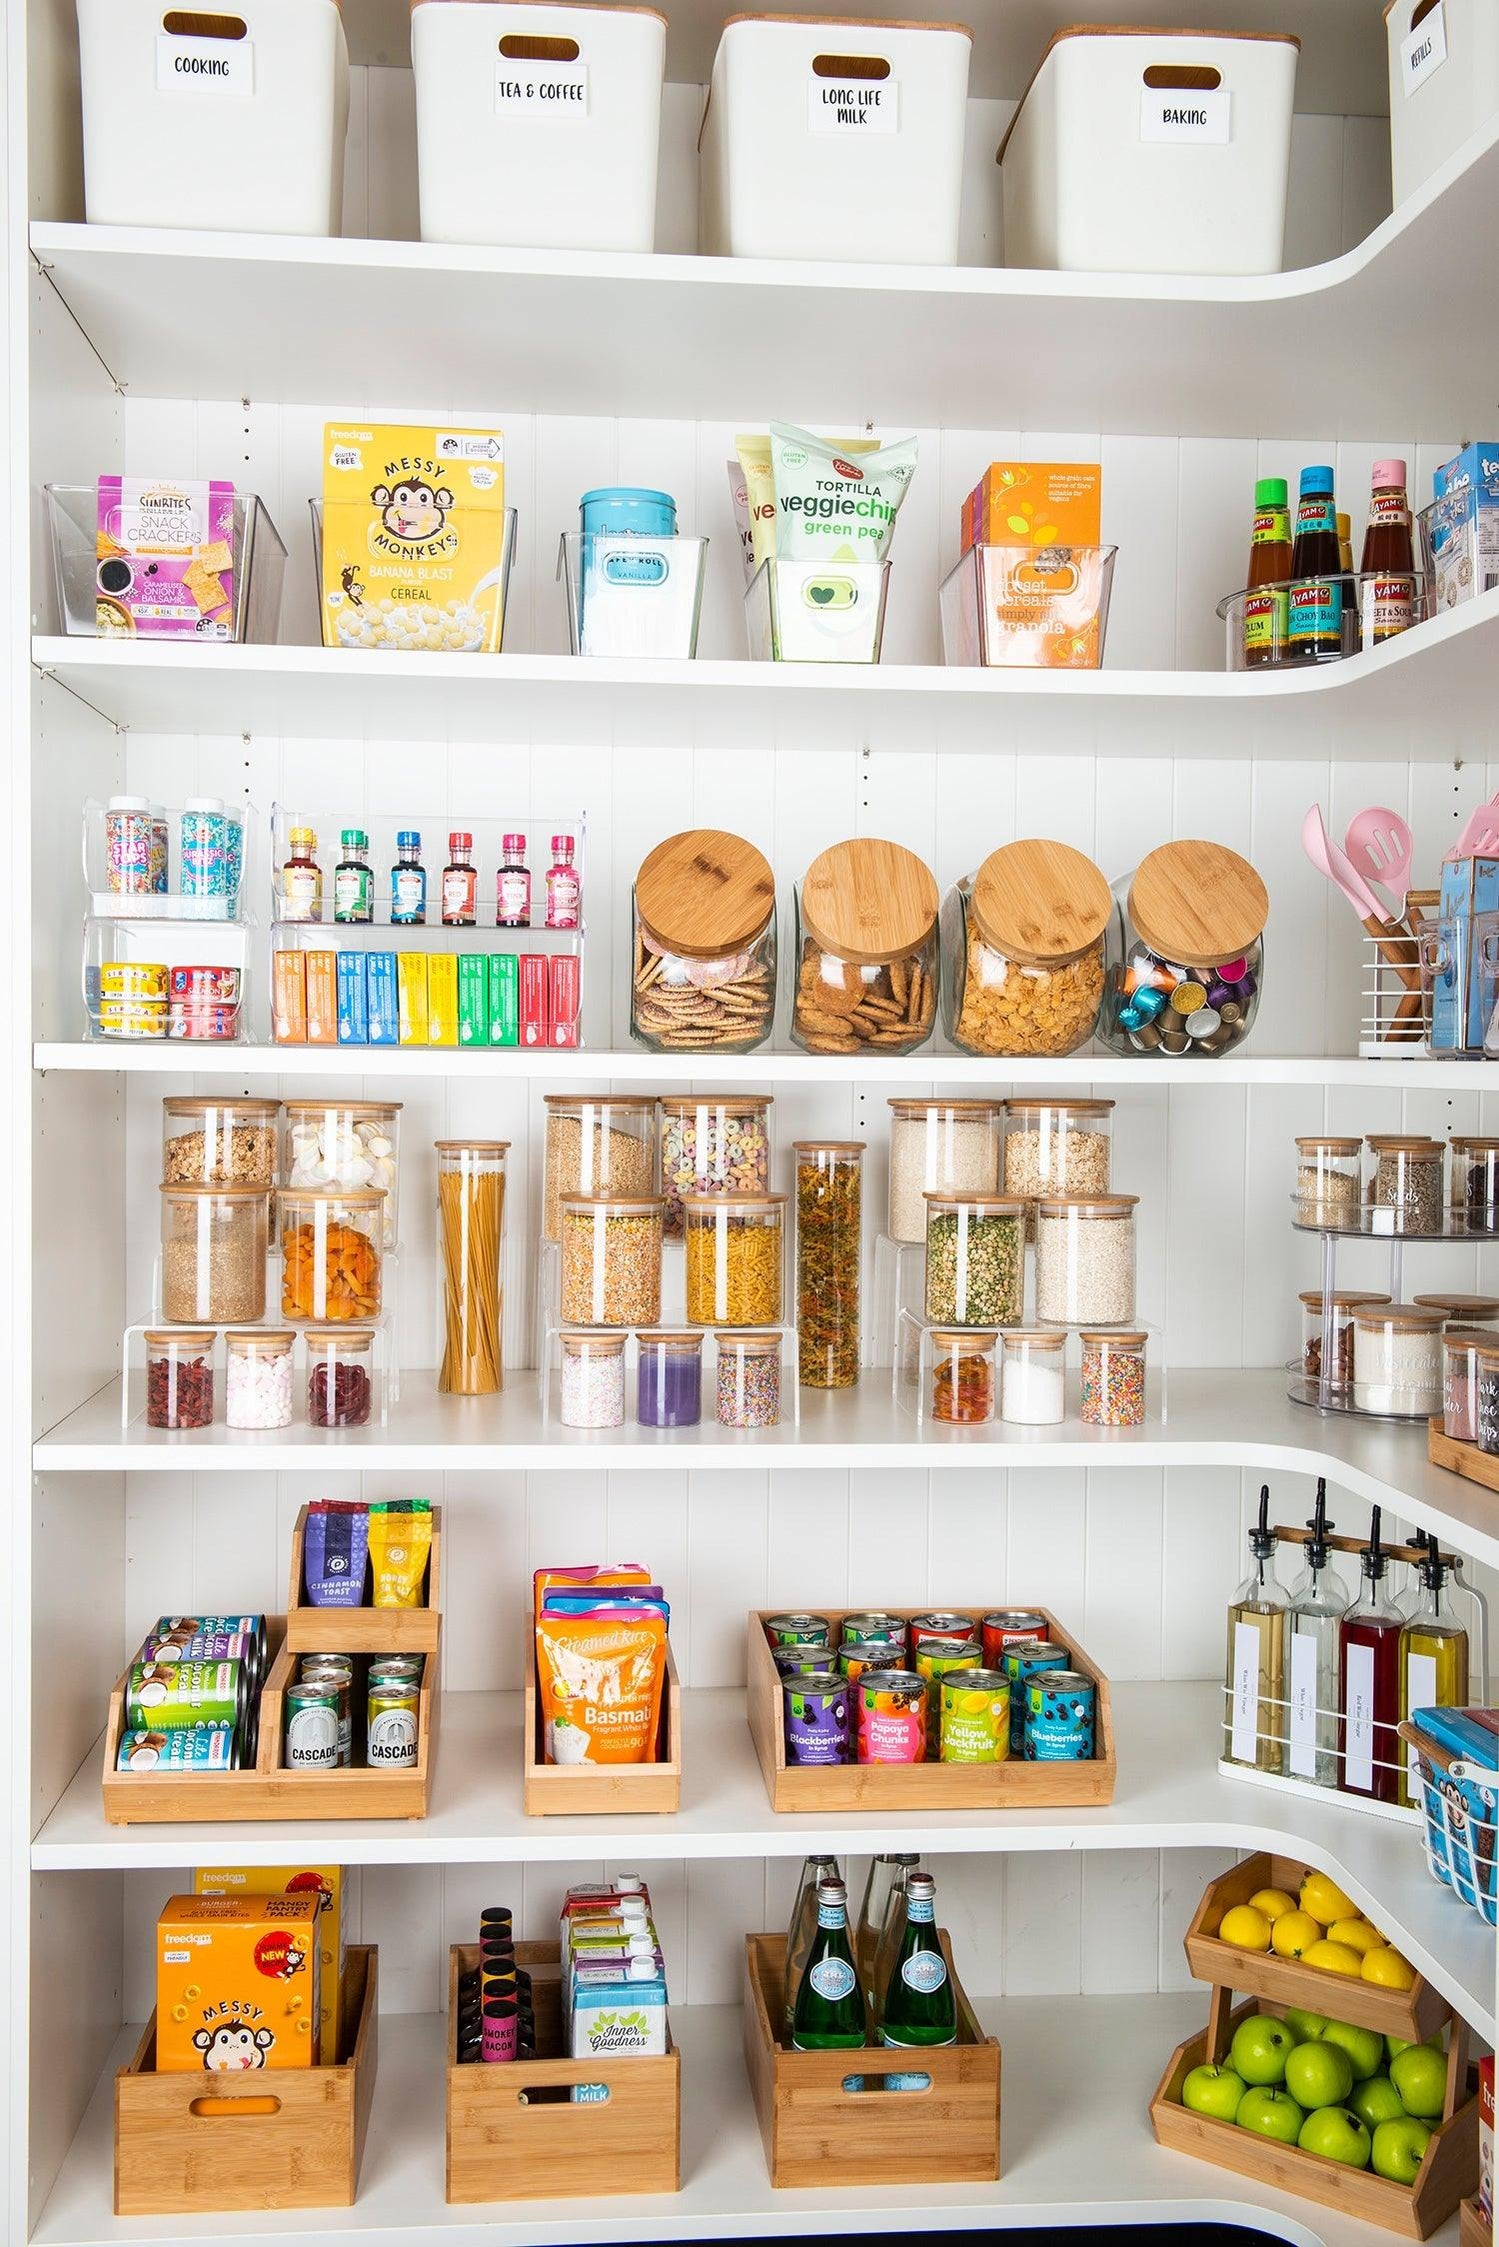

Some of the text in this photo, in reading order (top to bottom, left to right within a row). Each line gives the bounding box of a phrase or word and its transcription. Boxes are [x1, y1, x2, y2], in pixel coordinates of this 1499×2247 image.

[174, 57, 229, 77] COOKING
[499, 81, 583, 101] TEA & COFFEE
[823, 89, 882, 106] LONG LIFE
[838, 108, 867, 124] MILK
[1163, 108, 1207, 125] BAKING
[336, 457, 355, 465] FREE
[384, 457, 445, 477] MESSY
[816, 480, 882, 497] TORTILLA
[140, 497, 192, 510] SUNRITES
[781, 494, 898, 525] veggiechip
[1373, 499, 1400, 514] AYAM
[141, 516, 188, 529] SNACK
[804, 521, 884, 540] green pea
[127, 529, 202, 543] CRACKERS
[374, 534, 457, 558] MONKEYS
[369, 567, 454, 580] BANANA BLAST
[144, 588, 175, 596] ONION
[391, 588, 432, 600] CEREAL
[1290, 590, 1318, 609] AYAM
[112, 841, 147, 854] STAR
[112, 852, 149, 865] TOPS
[107, 970, 148, 978] SIRNA
[1479, 1381, 1498, 1397] ark
[311, 1580, 362, 1590] CINNAMON
[324, 1588, 350, 1596] TOAST
[204, 1616, 216, 1634] Cre
[190, 1636, 203, 1657] Milk
[214, 1636, 228, 1656] Lite
[556, 1629, 649, 1653] Steamed Rice
[178, 1663, 191, 1703] Cream
[190, 1661, 206, 1708] Coconut
[871, 1721, 909, 1735] Papaya
[950, 1724, 987, 1738] Yellow
[1031, 1729, 1083, 1742] Blueberries
[790, 1733, 845, 1746] Blackberries
[871, 1732, 909, 1744] Chunks
[944, 1734, 995, 1750] Jackfruit
[170, 1730, 186, 1768] Cream
[194, 1737, 208, 1758] Lite
[293, 1745, 336, 1761] CASCADE
[372, 1742, 418, 1759] CASCADE
[202, 1872, 246, 1882] freedom
[165, 1933, 212, 1944] freedom
[261, 1950, 285, 1962] NEW
[202, 2000, 263, 2022] MESSY
[602, 2024, 640, 2037] Inner
[485, 2041, 513, 2051] BACON
[590, 2034, 647, 2052] Goodness
[580, 2091, 607, 2103] MILK
